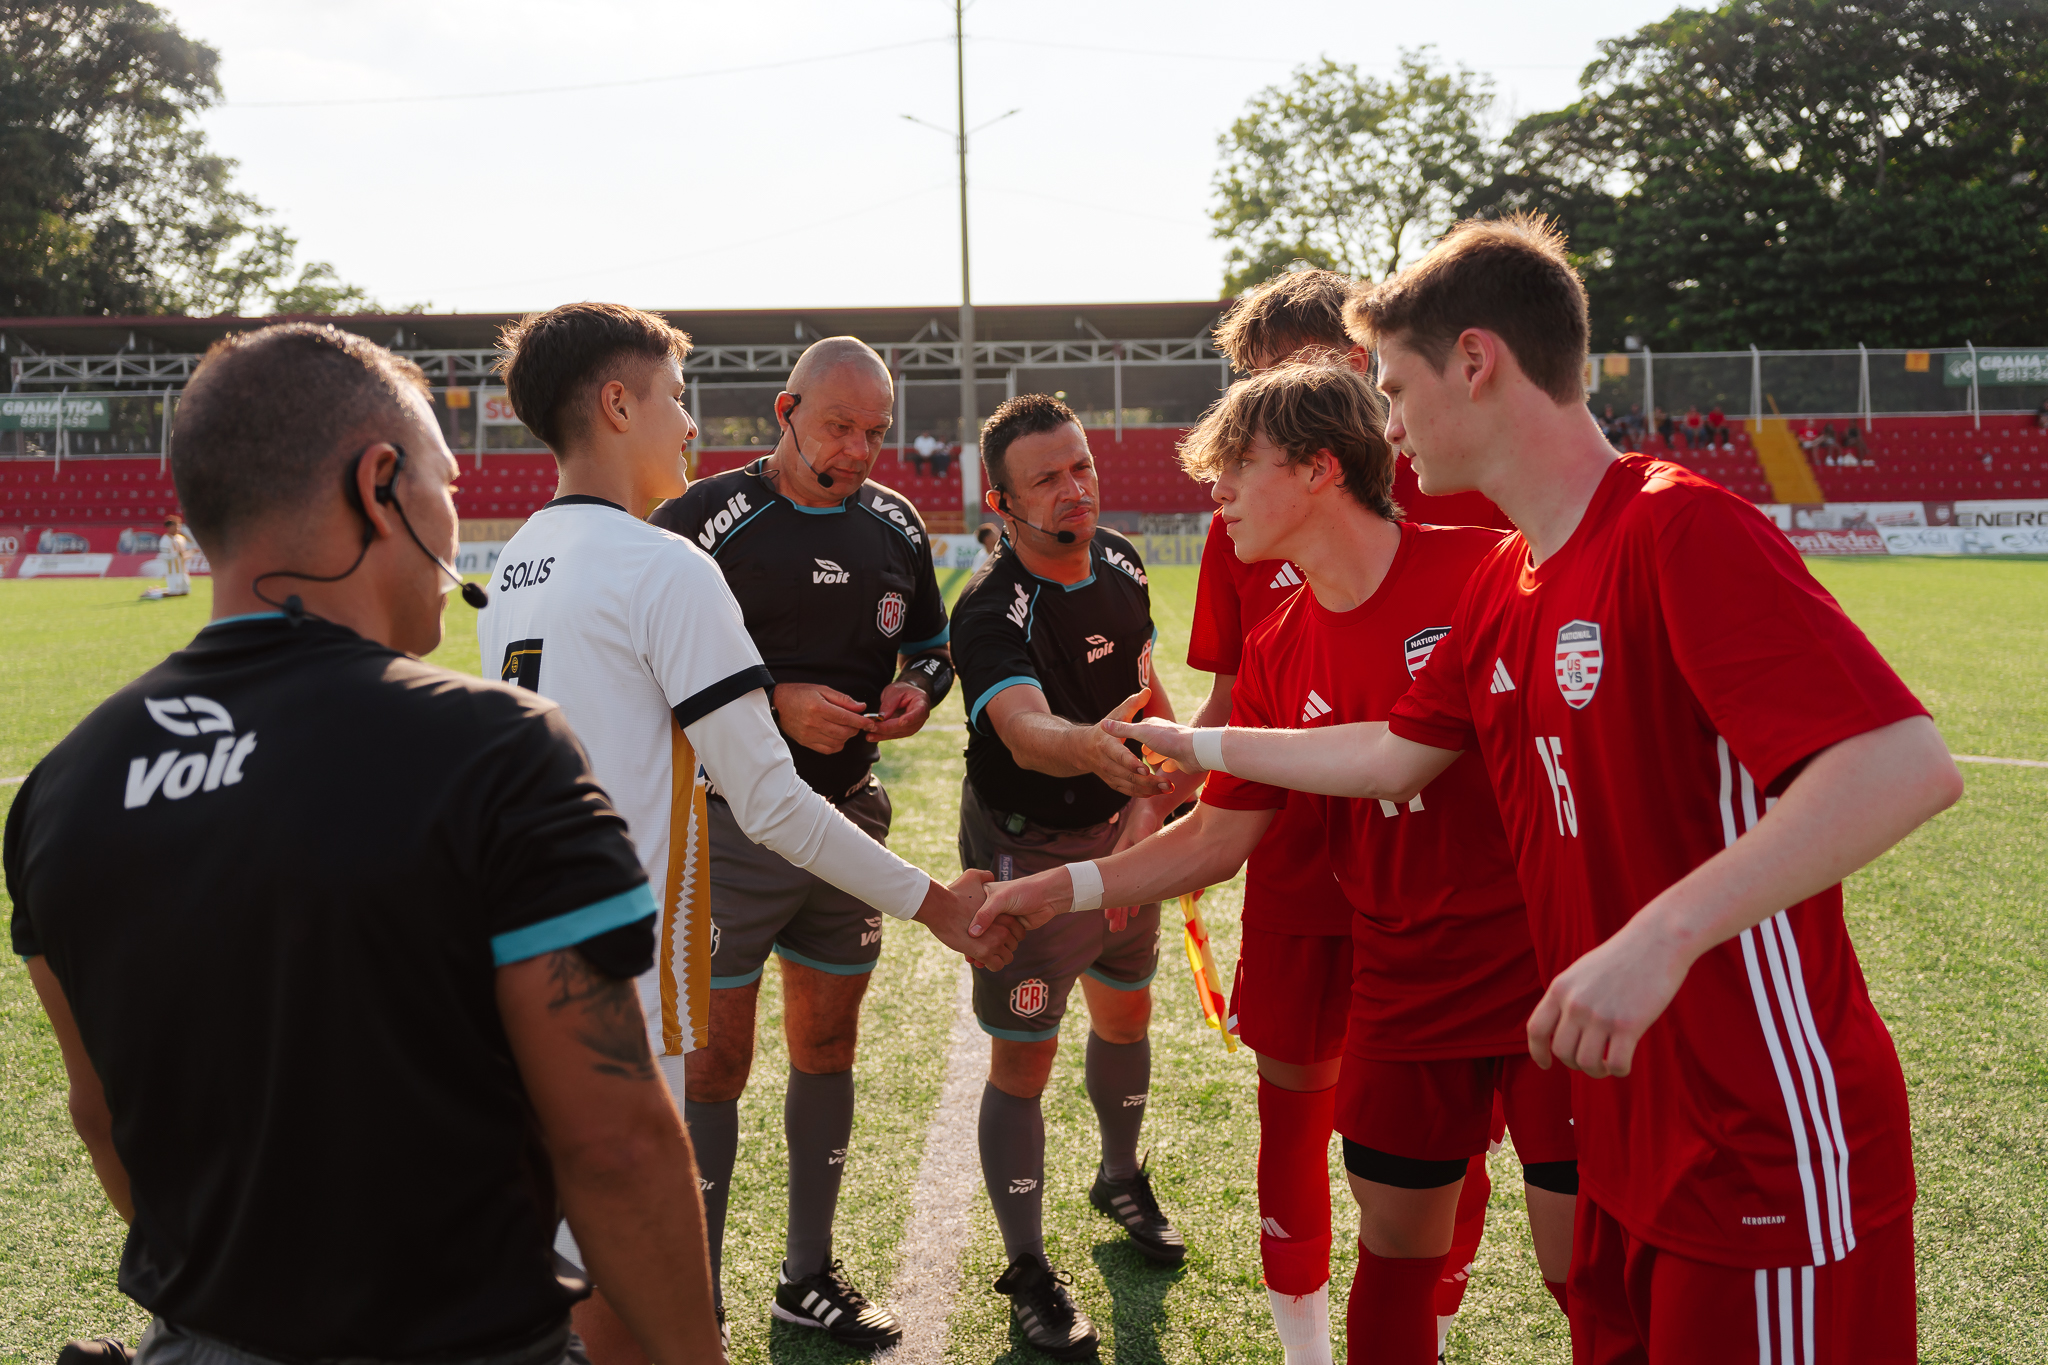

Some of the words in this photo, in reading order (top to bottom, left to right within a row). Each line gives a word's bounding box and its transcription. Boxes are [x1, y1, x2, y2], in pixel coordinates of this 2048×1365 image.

[698, 491, 752, 550] Voit
[500, 556, 556, 592] SOLIS
[812, 571, 850, 584] Voit
[1086, 641, 1115, 664] Voit
[1567, 658, 1581, 671] US
[1567, 671, 1583, 684] YS
[123, 730, 258, 810] Voit
[1535, 736, 1579, 838] 15
[1001, 856, 1011, 881] Respe
[1018, 985, 1041, 1011] CR
[1742, 1215, 1786, 1226] AEROREADY
